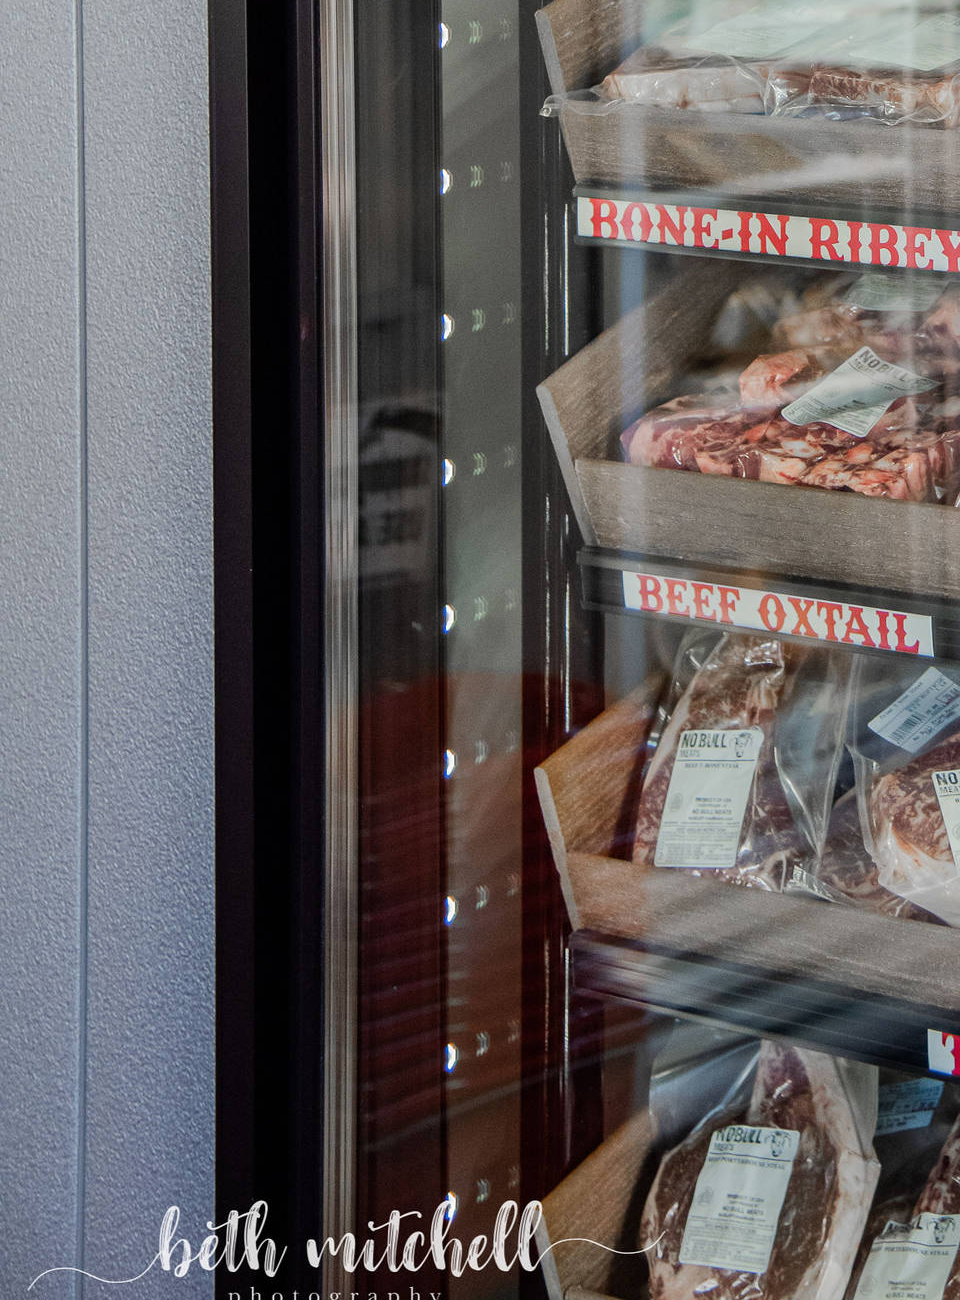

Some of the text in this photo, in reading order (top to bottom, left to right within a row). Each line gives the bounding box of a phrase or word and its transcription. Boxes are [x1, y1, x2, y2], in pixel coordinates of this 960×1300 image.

[590, 198, 791, 254] BONE-IN
[636, 573, 921, 656] BEEF OXTAIL
[681, 733, 727, 748] NO BULL
[935, 772, 958, 786] NO
